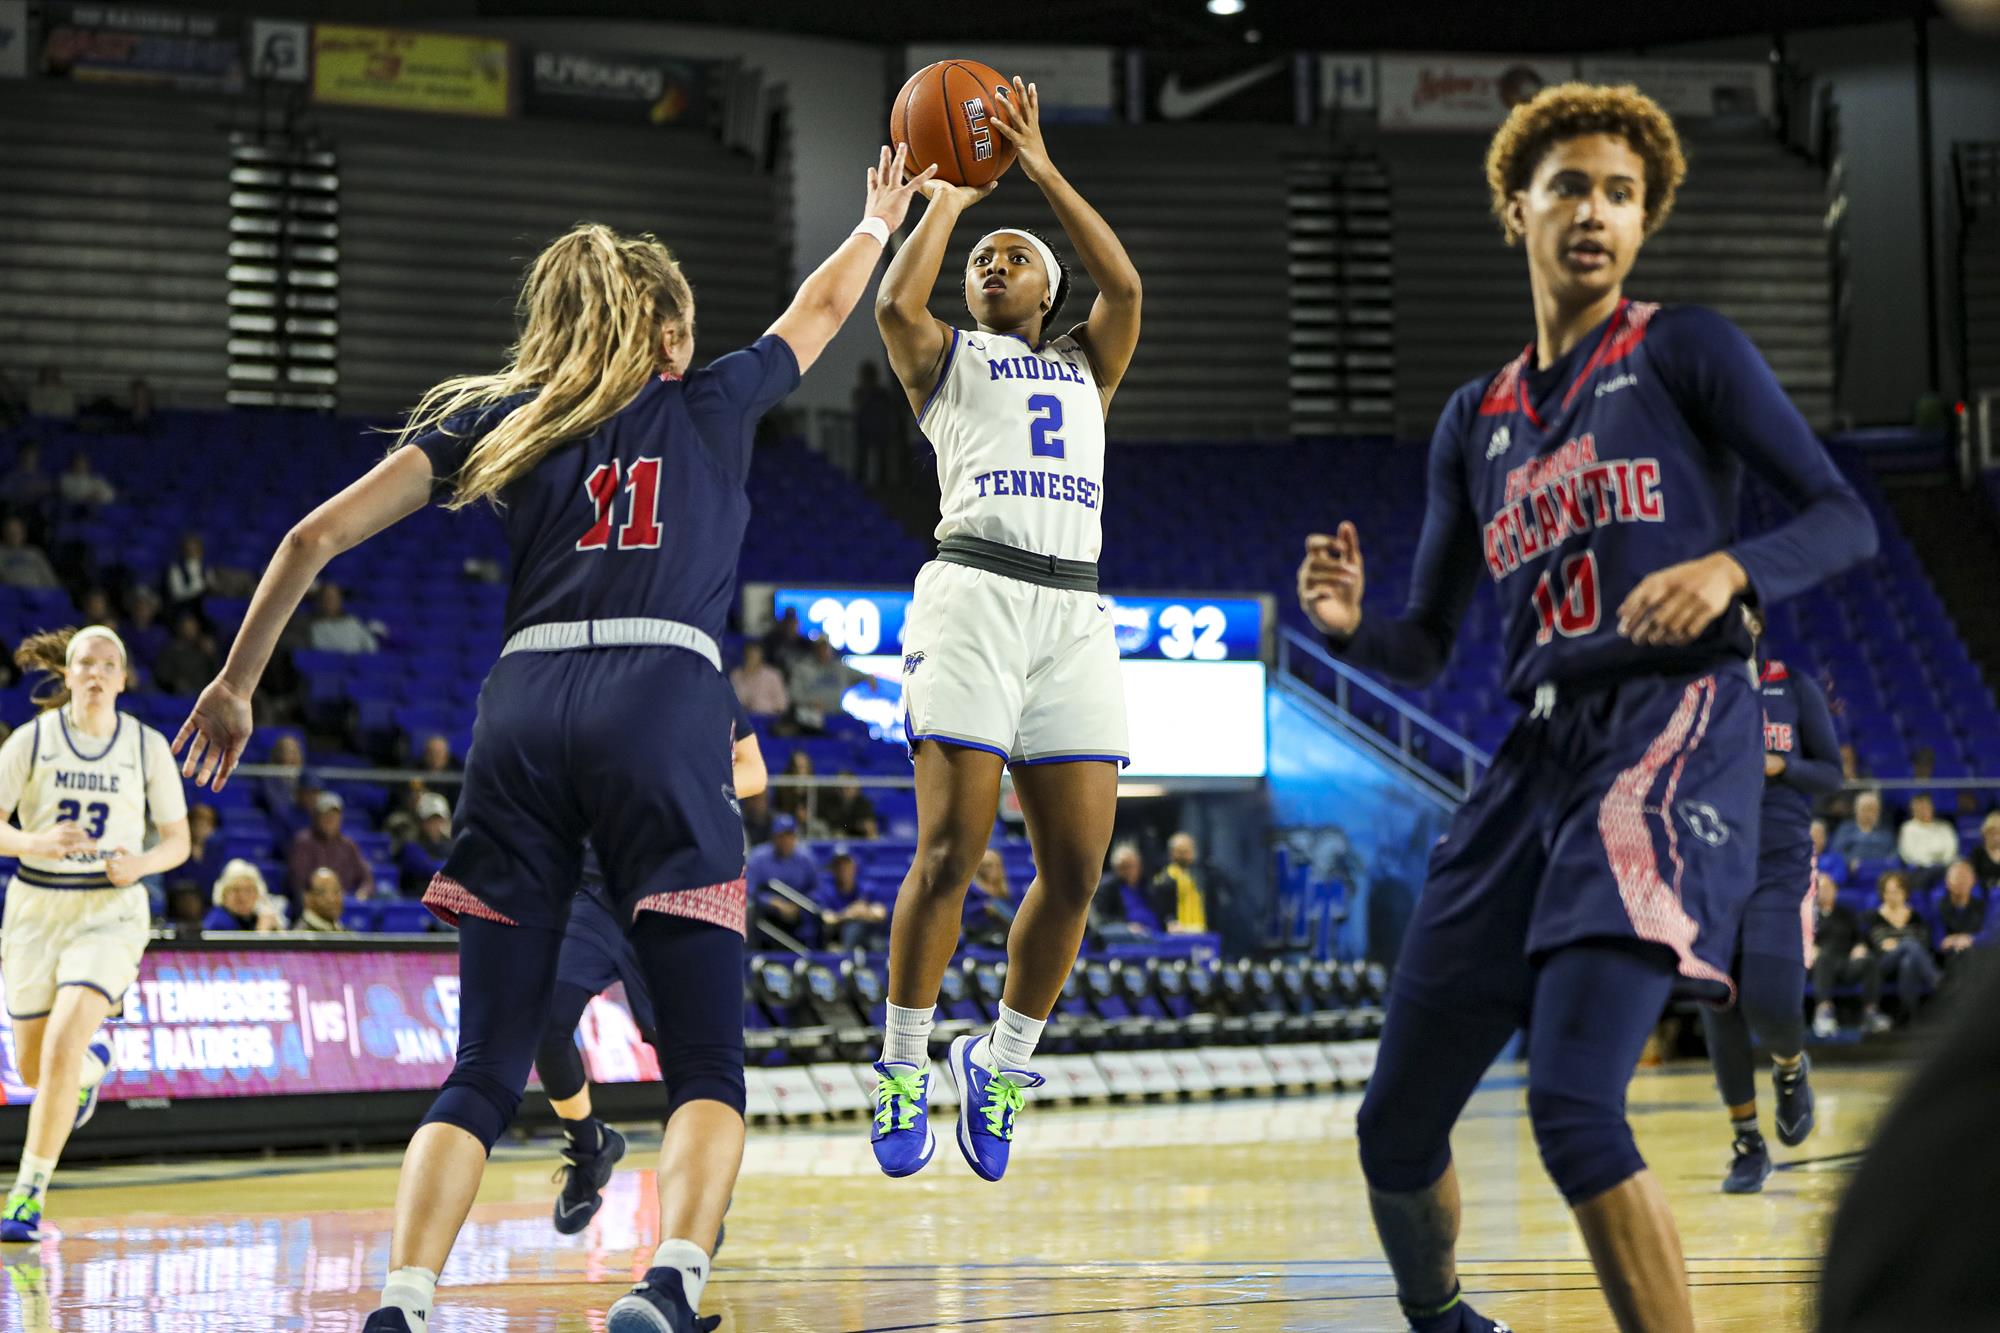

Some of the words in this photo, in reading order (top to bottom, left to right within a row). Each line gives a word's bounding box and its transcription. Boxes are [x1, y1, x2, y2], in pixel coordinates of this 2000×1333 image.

[964, 97, 993, 162] ELITE
[987, 355, 1086, 385] MIDDLE
[1026, 391, 1068, 462] 2
[575, 456, 664, 552] 11
[974, 469, 1100, 511] TENNESSE
[1483, 457, 1665, 584] ATLANTIC
[1531, 548, 1601, 647] 10
[1158, 604, 1228, 660] 32
[54, 769, 121, 794] MIDDLE
[55, 798, 110, 840] 23
